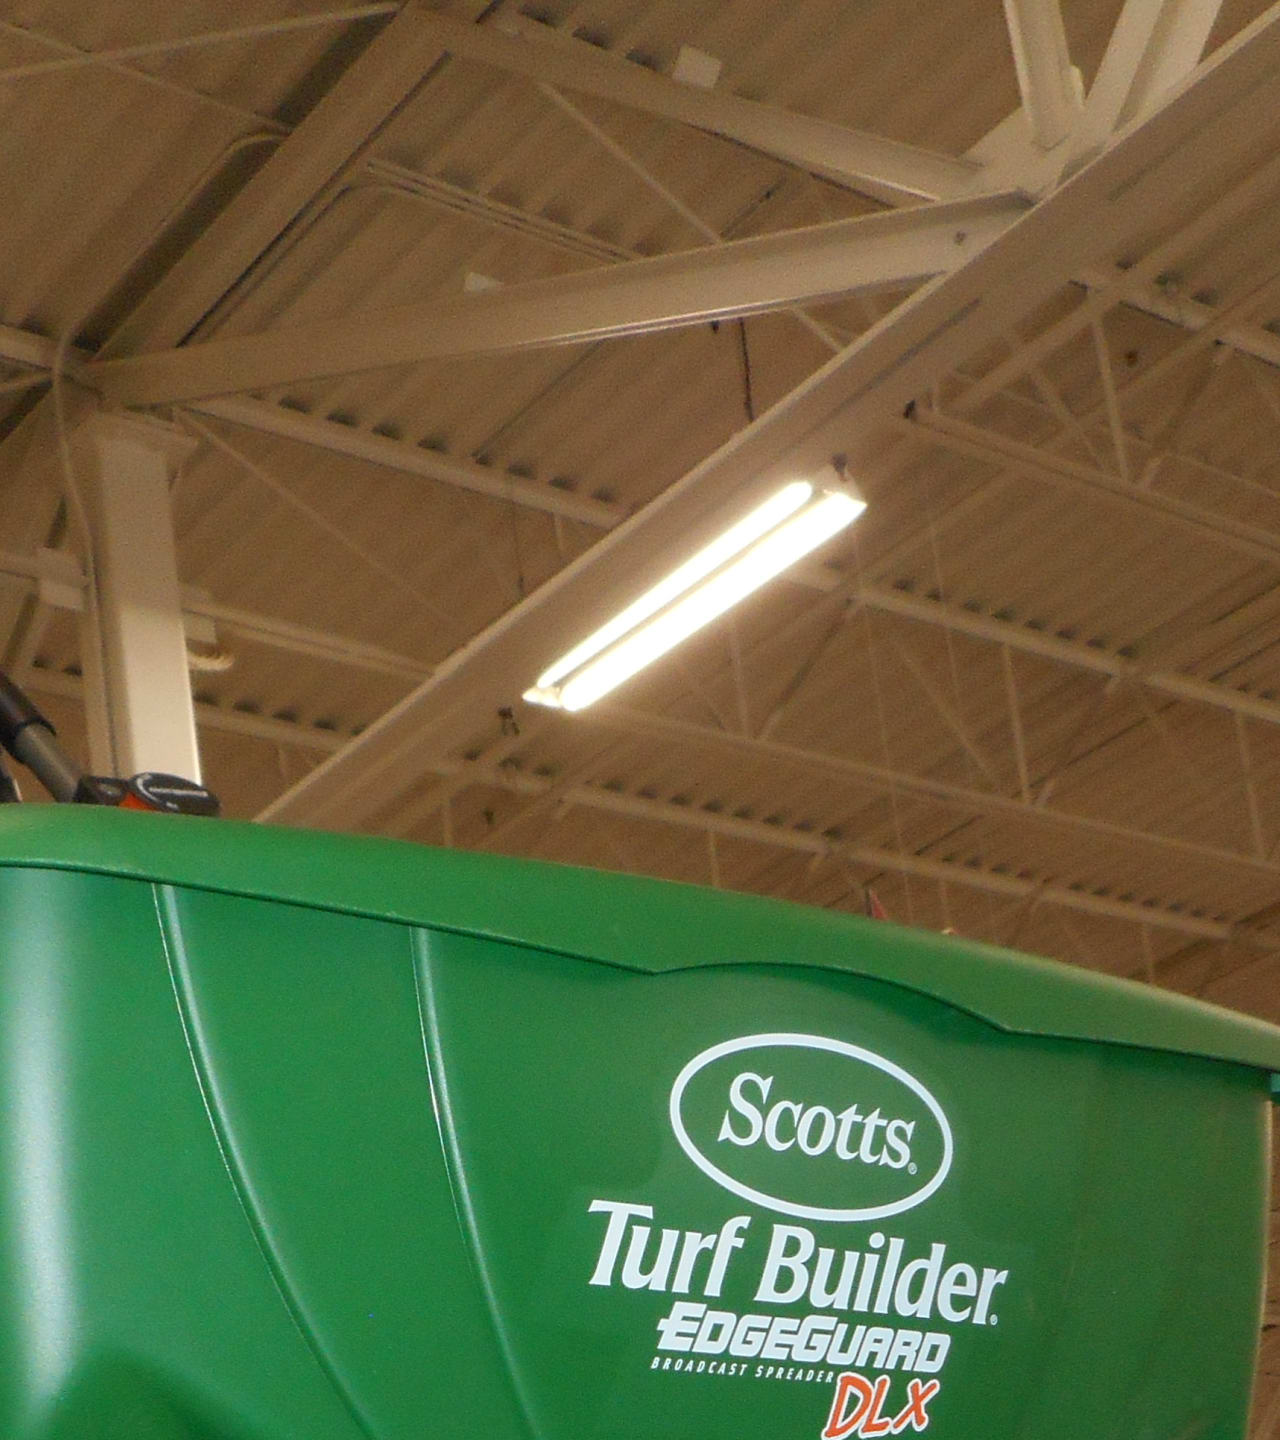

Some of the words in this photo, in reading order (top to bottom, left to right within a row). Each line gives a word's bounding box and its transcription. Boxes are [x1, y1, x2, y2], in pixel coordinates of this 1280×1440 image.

[718, 1072, 916, 1170] Scotts
[588, 1199, 751, 1297] Turf
[754, 1224, 1008, 1326] Builder
[651, 1357, 748, 1377] BROADCAST
[755, 1366, 835, 1384] SPREADER
[657, 1301, 951, 1373] EDGEGUARD
